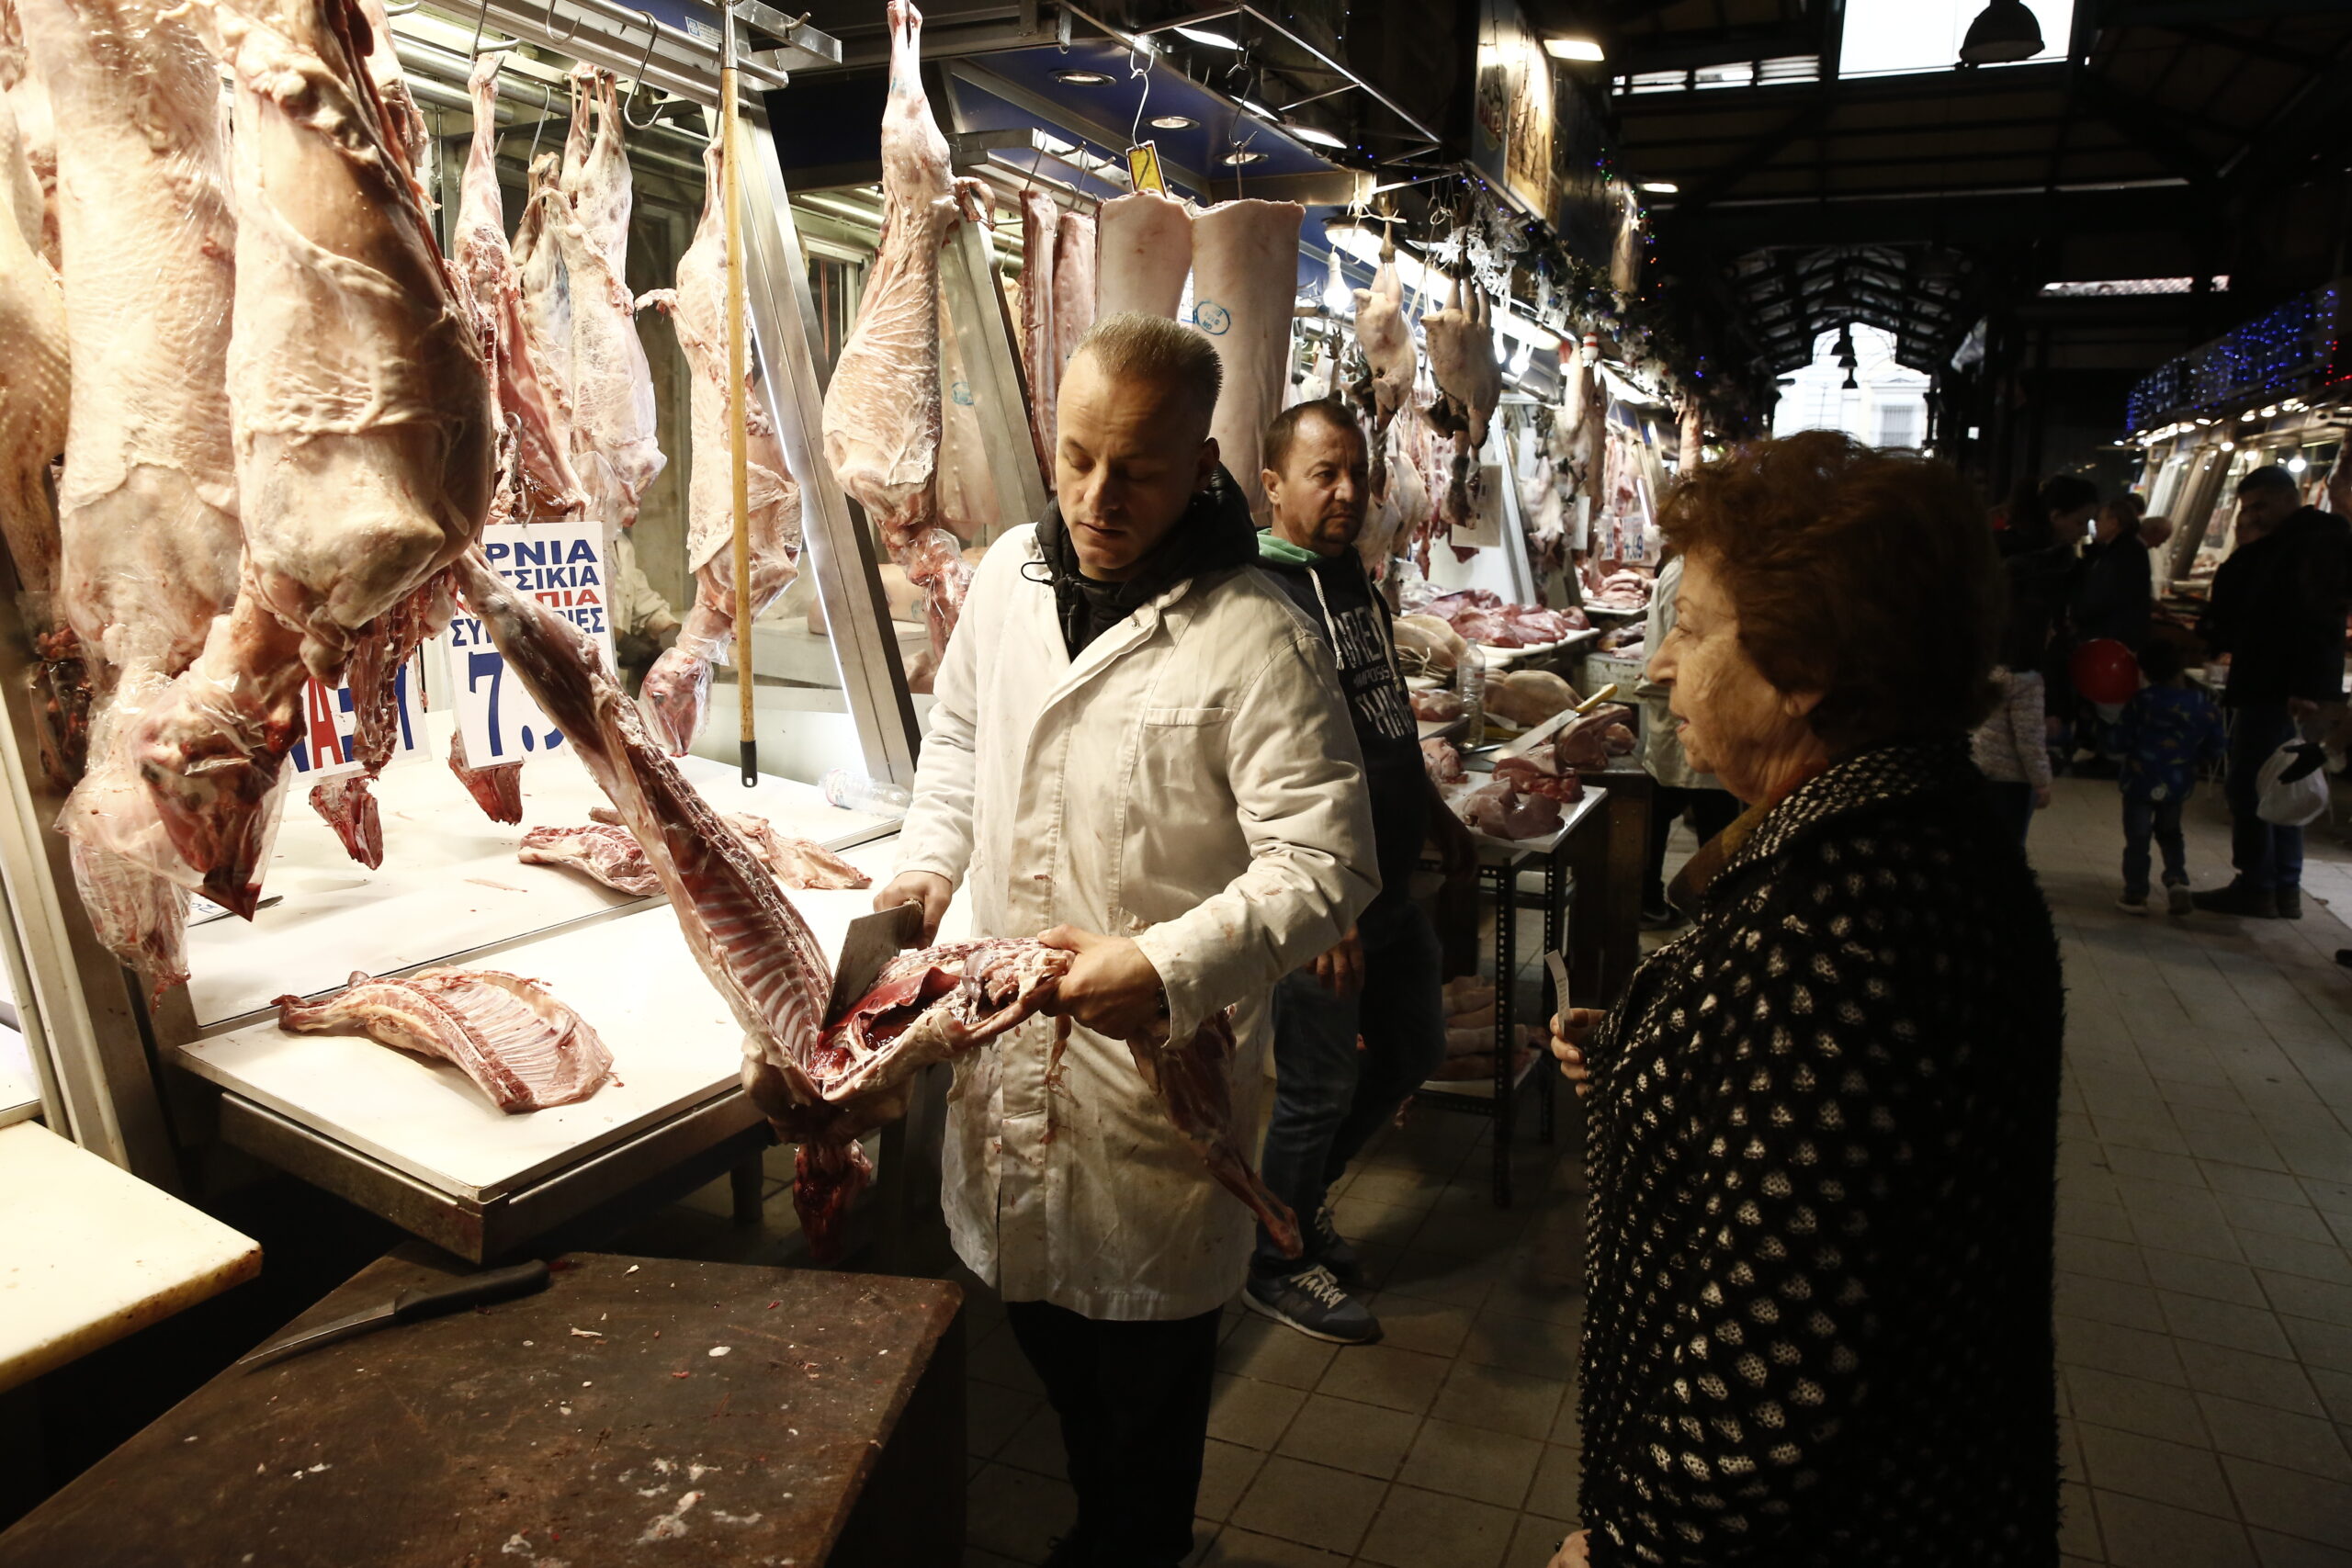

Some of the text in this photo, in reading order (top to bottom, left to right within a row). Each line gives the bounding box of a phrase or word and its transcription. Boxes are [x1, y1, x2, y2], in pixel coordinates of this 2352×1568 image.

[485, 539, 598, 567] ΡΝΙΑ
[500, 565, 600, 591] ΣΙΚΙΑ
[469, 651, 564, 757] 7.
